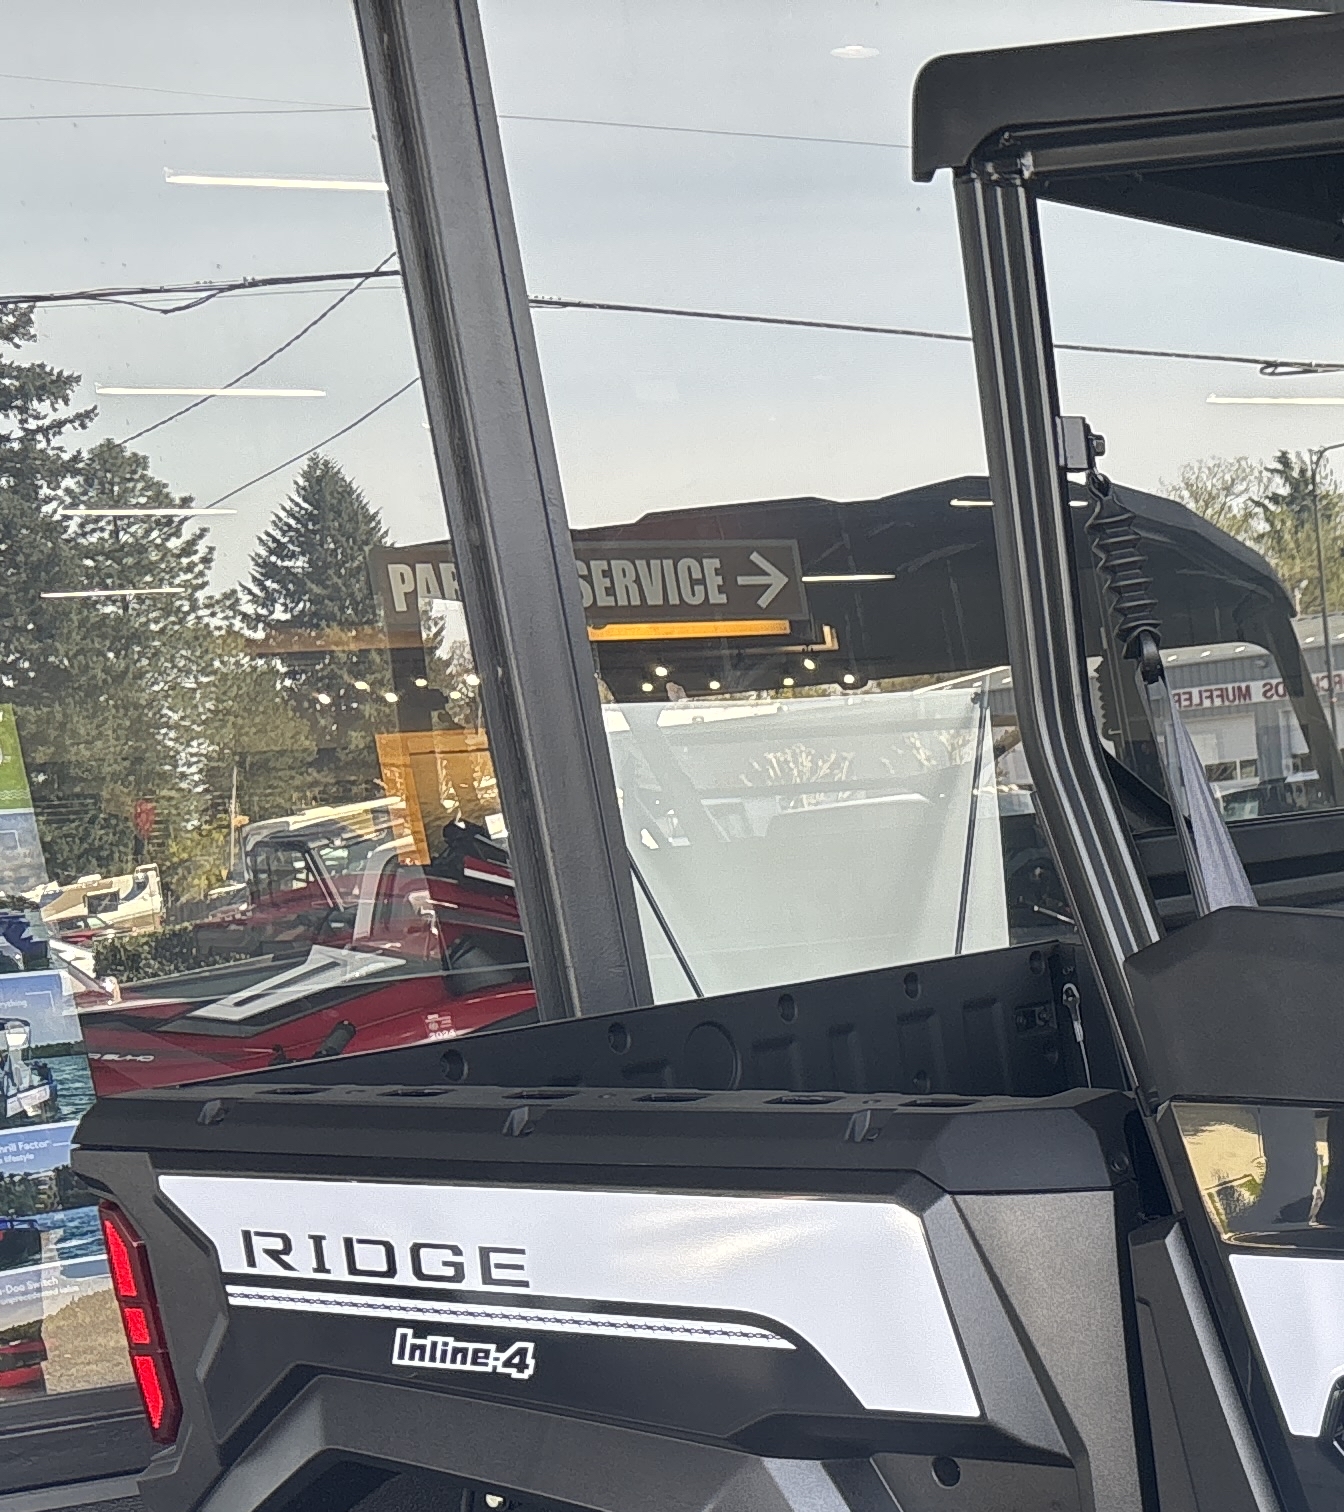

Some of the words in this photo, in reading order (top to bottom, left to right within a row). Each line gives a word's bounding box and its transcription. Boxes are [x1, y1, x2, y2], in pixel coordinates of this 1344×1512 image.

[577, 557, 728, 609] SERVICE
[241, 1229, 531, 1289] RIDGE
[392, 1328, 536, 1380] Inline-4
